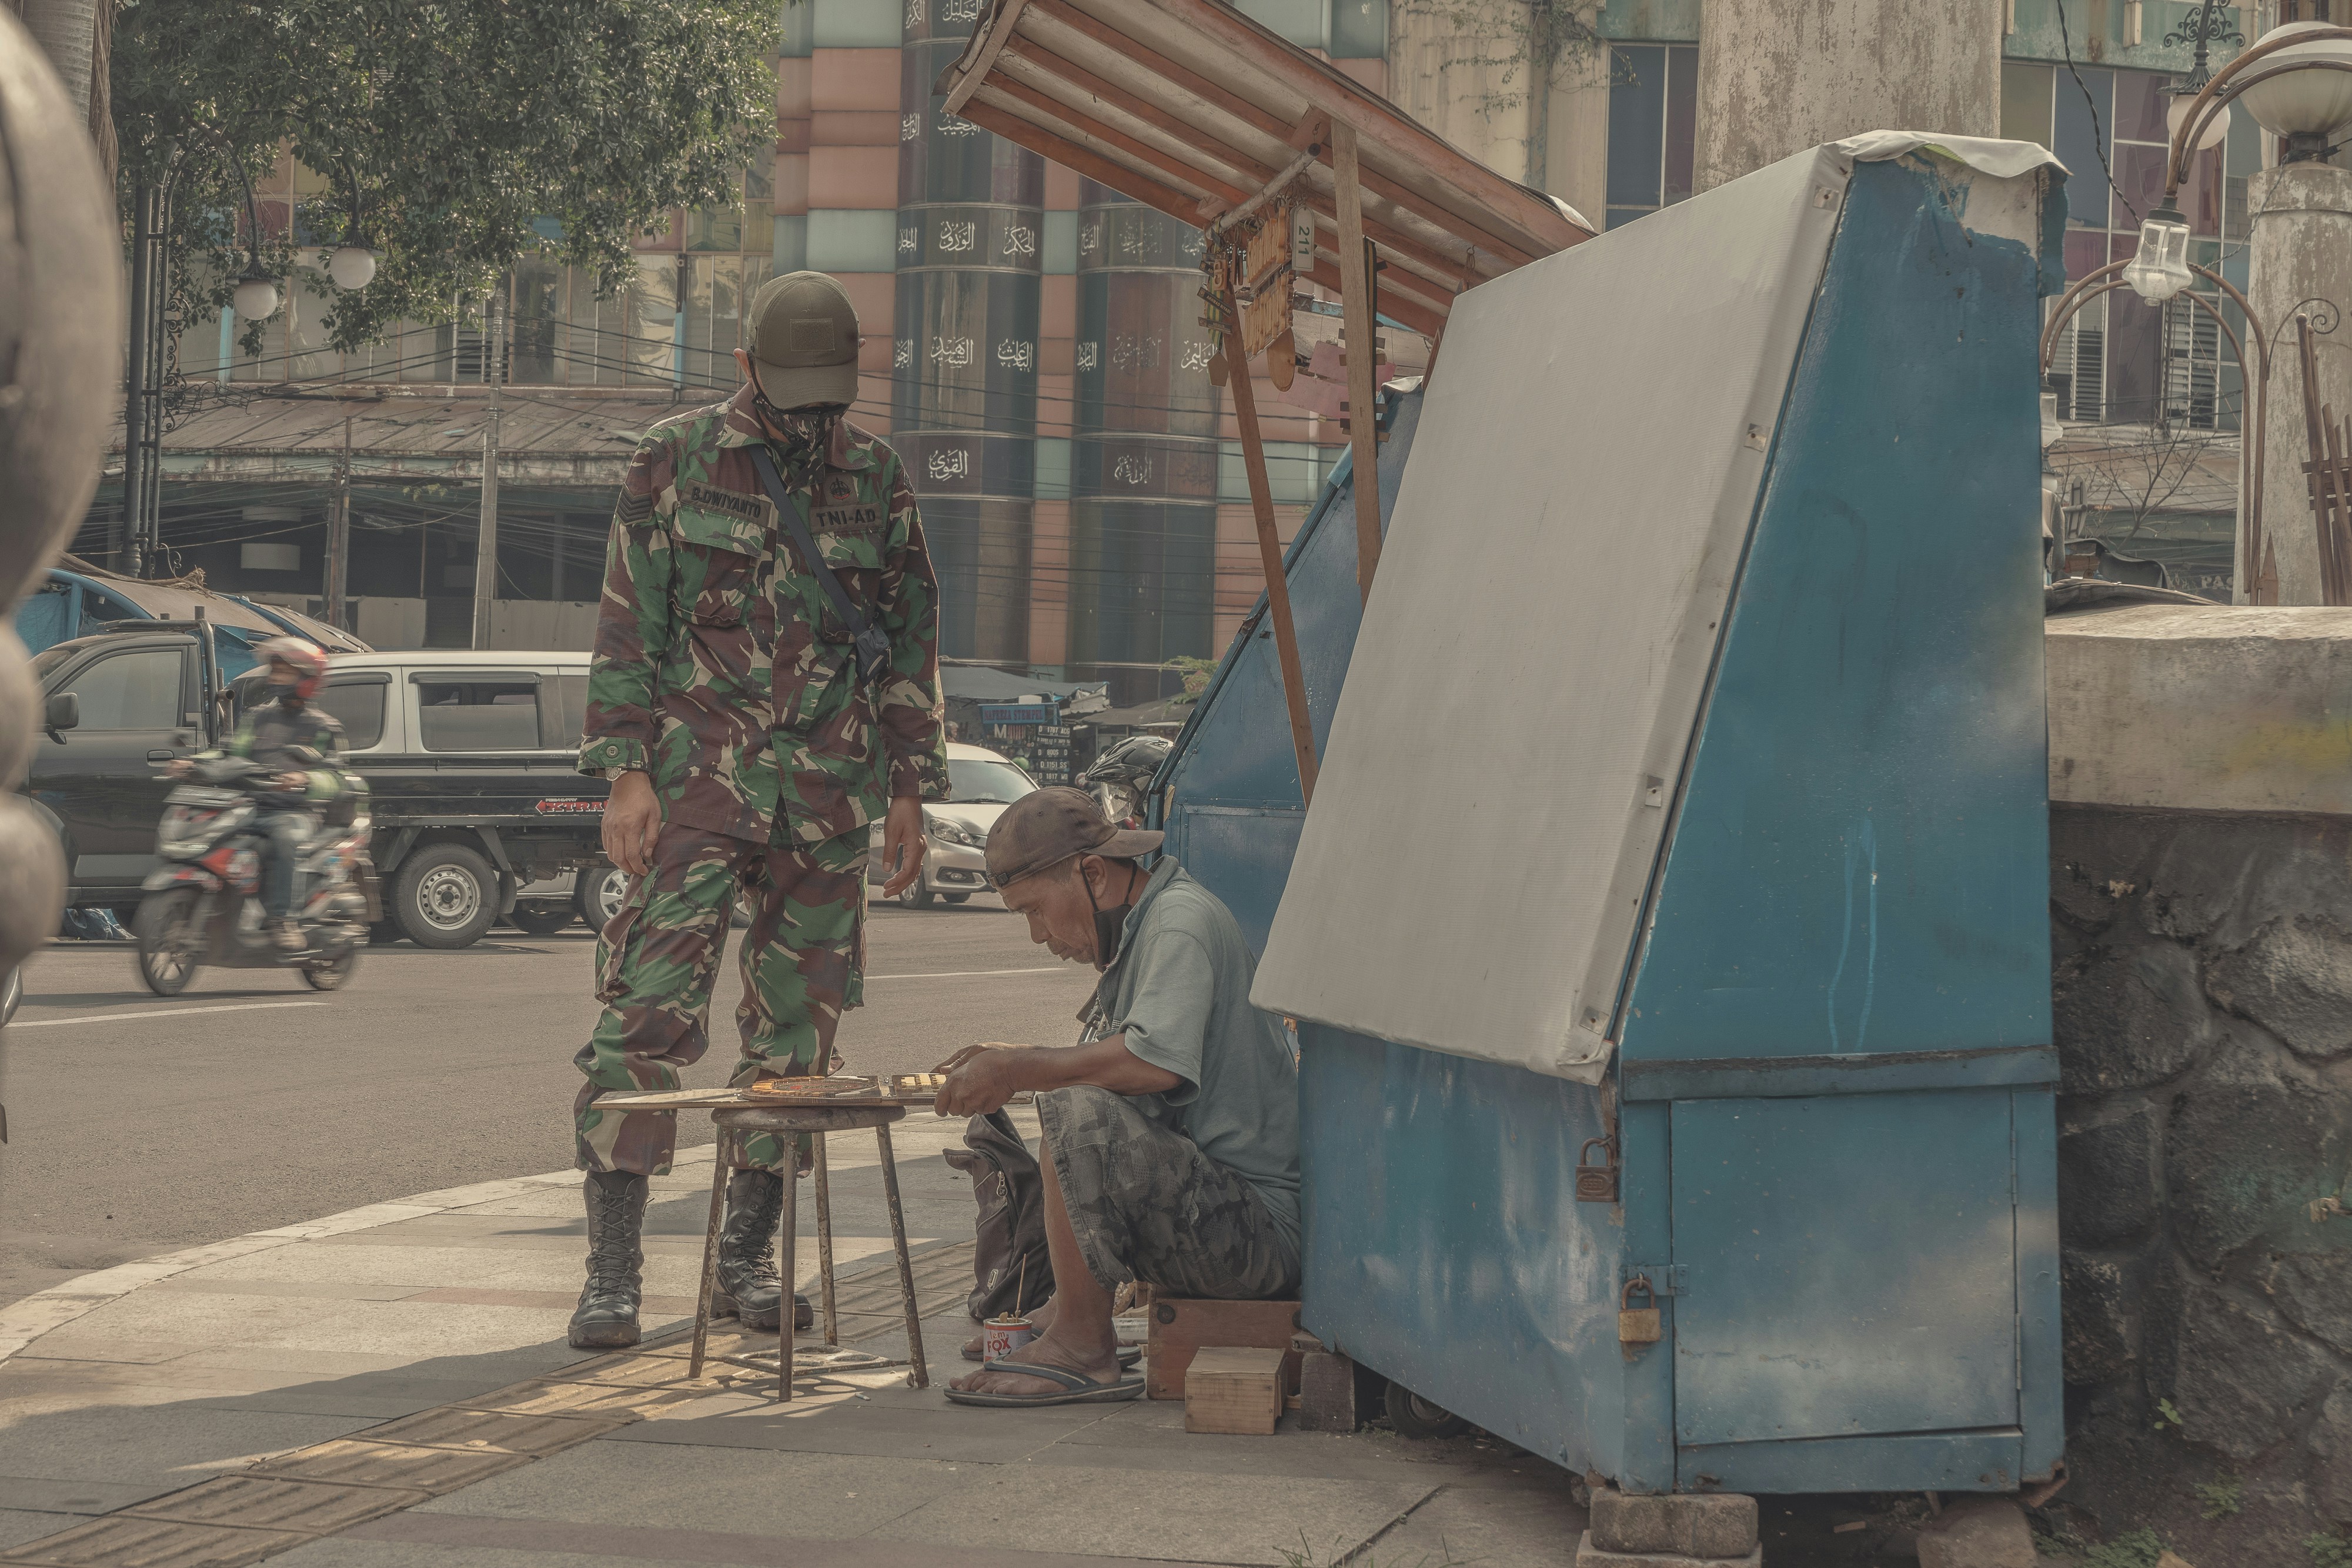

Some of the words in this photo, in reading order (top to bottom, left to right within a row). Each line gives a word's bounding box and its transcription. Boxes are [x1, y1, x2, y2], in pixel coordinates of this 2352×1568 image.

[1298, 225, 1309, 255] 211
[1220, 303, 1231, 314] RIYADI
[691, 487, 761, 518] B.DWIYANTO
[816, 509, 876, 527] TNI-AD
[994, 724, 1007, 738] M
[546, 802, 604, 812] XTRA
[987, 1337, 1011, 1353] FOX
